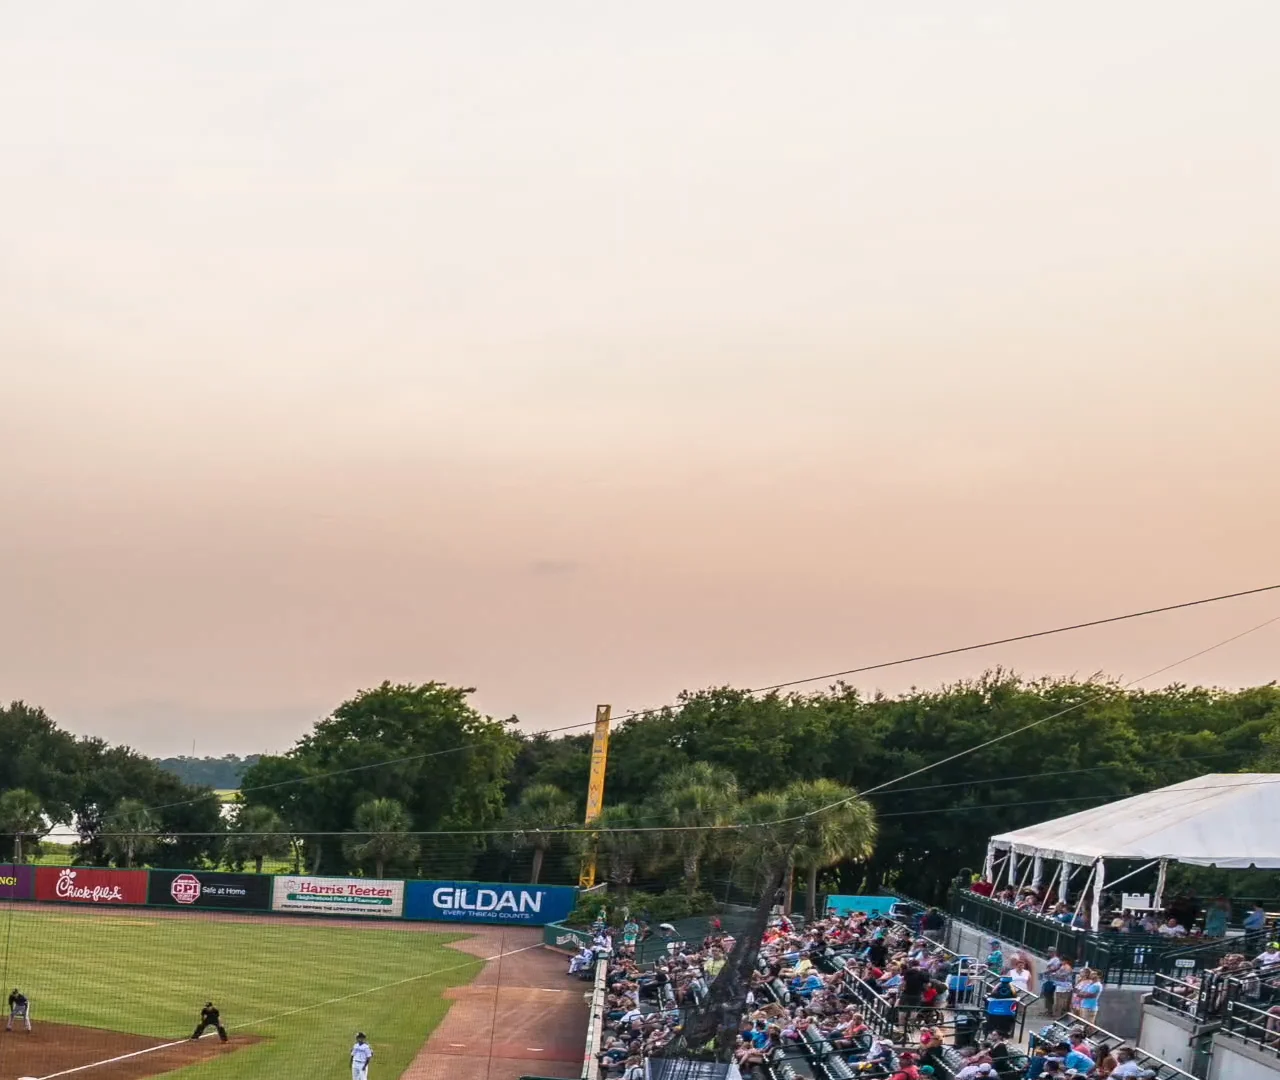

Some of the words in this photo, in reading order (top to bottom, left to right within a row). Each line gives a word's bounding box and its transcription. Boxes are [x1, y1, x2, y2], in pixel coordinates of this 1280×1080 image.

[55, 869, 123, 902] Chick-fil-A
[173, 883, 198, 894] CPI
[202, 886, 217, 894] Safe
[226, 887, 246, 895] Home
[300, 882, 344, 895] Harris
[347, 884, 393, 897] Teeter
[432, 887, 542, 913] GILDAN
[467, 910, 497, 918] THREAD
